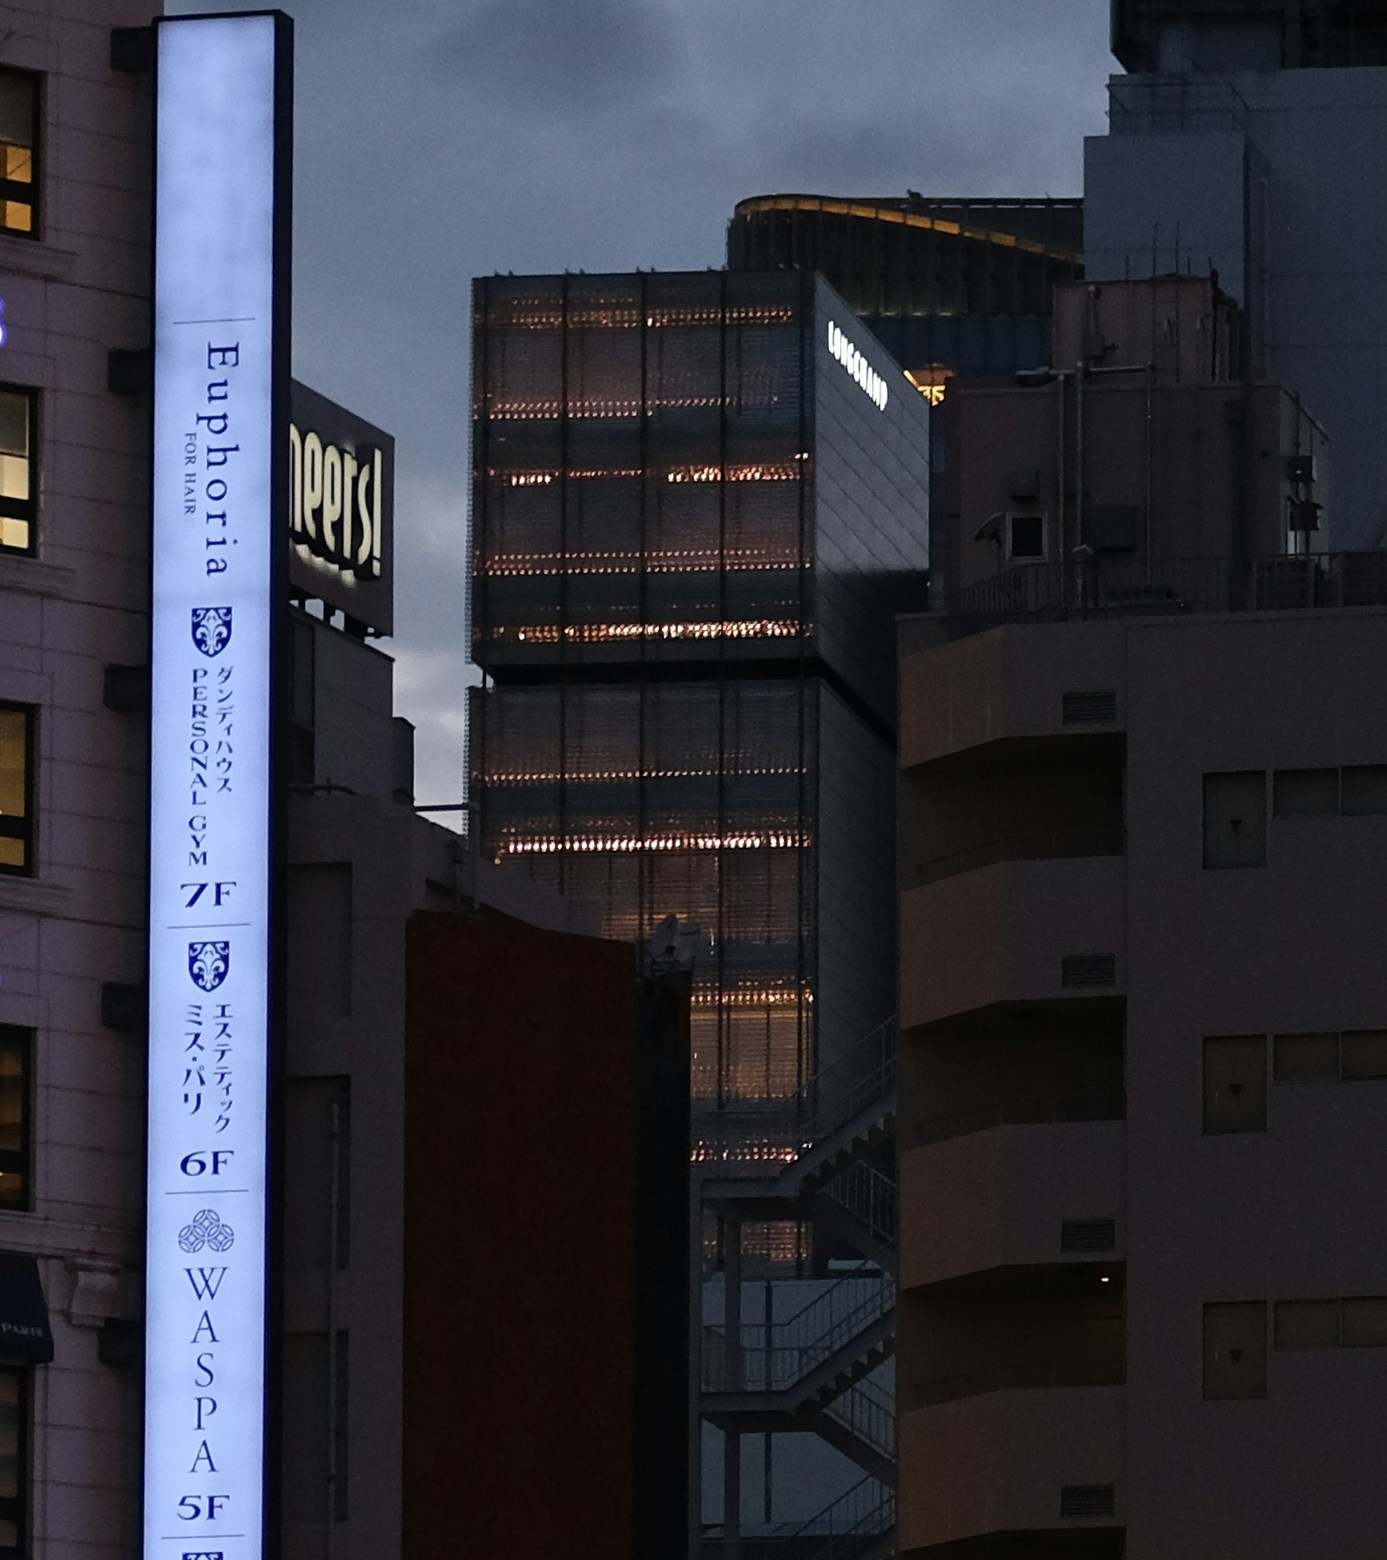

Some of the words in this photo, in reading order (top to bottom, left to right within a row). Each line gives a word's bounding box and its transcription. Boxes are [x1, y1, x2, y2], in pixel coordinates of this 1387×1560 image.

[185, 432, 197, 465] FOR
[196, 342, 240, 577] Euphoria
[184, 473, 197, 515] HAIR
[190, 668, 209, 806] PERSONAL
[215, 666, 234, 793] ダンディハウス
[188, 815, 208, 866] GYM
[180, 881, 237, 908] 7F
[182, 1004, 205, 1116] ミス・パリ
[213, 1003, 234, 1133] エステティック
[180, 1150, 235, 1176] 6F
[183, 1267, 229, 1473] WASPA
[177, 1495, 231, 1521] 5F
